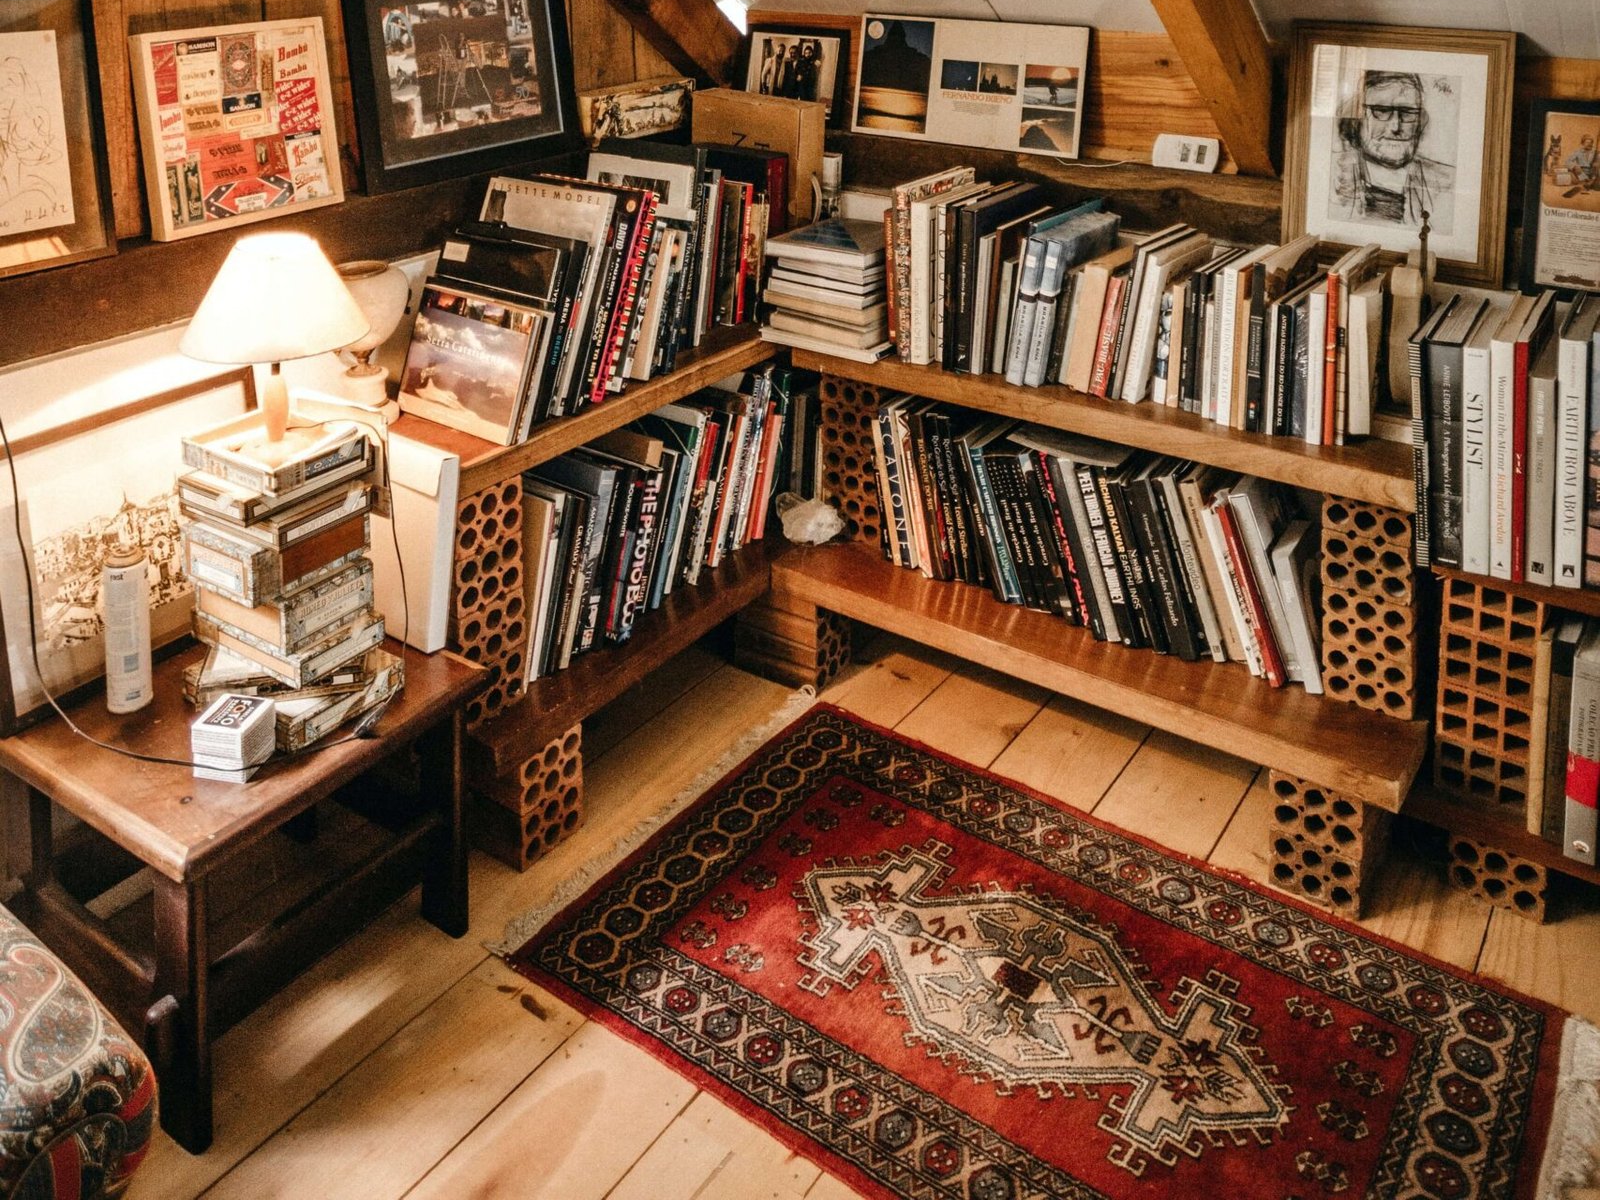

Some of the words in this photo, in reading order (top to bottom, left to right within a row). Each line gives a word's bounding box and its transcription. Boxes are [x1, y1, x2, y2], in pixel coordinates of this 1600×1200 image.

[492, 182, 548, 198] LISETTE
[552, 191, 602, 206] MODEL
[614, 223, 627, 249] DAVID
[559, 297, 570, 323] ARENA
[1279, 314, 1288, 338] ANTIGAS
[426, 333, 450, 350] Serra
[1278, 338, 1287, 364] FAZENDAS
[1442, 364, 1450, 387] ANNIE
[1276, 384, 1284, 407] GRANDE
[1496, 375, 1506, 410] Woman
[1442, 389, 1451, 425] LEIBOVITZ
[1497, 412, 1506, 421] in
[1564, 395, 1580, 442] EARTH
[931, 434, 939, 447] Rio
[942, 437, 950, 450] Rio
[1465, 392, 1485, 470] STYLIST
[1497, 423, 1507, 438] the
[917, 437, 925, 453] RIO
[1496, 439, 1506, 471] Mirror
[918, 454, 930, 481] GRANDE
[933, 447, 943, 470] Grande
[944, 450, 954, 474] Grande
[1563, 446, 1578, 486] FROM
[641, 471, 662, 514] THE
[713, 466, 727, 510] CAMERA
[938, 479, 946, 492] Sul
[950, 482, 958, 496] Sul
[1078, 470, 1094, 494] PETE
[1495, 473, 1507, 510] Richard
[942, 502, 951, 525] Leonid
[954, 506, 964, 529] Leonid
[1000, 499, 1011, 521] Brasil
[1011, 502, 1022, 524] Brasil
[1025, 502, 1035, 524] Brasil
[1084, 493, 1103, 527] TURNER
[1561, 493, 1577, 536] ABOVE
[1495, 511, 1506, 544] Avedon
[571, 525, 583, 565] GRAMADO
[1010, 533, 1023, 563] Coração
[1021, 535, 1036, 566] Coração
[1035, 535, 1049, 565] Coração
[1093, 527, 1113, 566] AFRICAN
[1098, 477, 1114, 516] RICHARD
[1108, 517, 1124, 552] KALVAR
[1119, 554, 1140, 609] EARTHLINGS
[1151, 548, 1162, 566] Luiz
[1182, 540, 1201, 590] Montevideo
[634, 574, 650, 601] Brasil
[1103, 565, 1124, 605] JOURNEY
[1156, 566, 1169, 590] Carlos
[1164, 591, 1180, 626] Felizardo
[1587, 699, 1597, 737] COLEÇÃO
